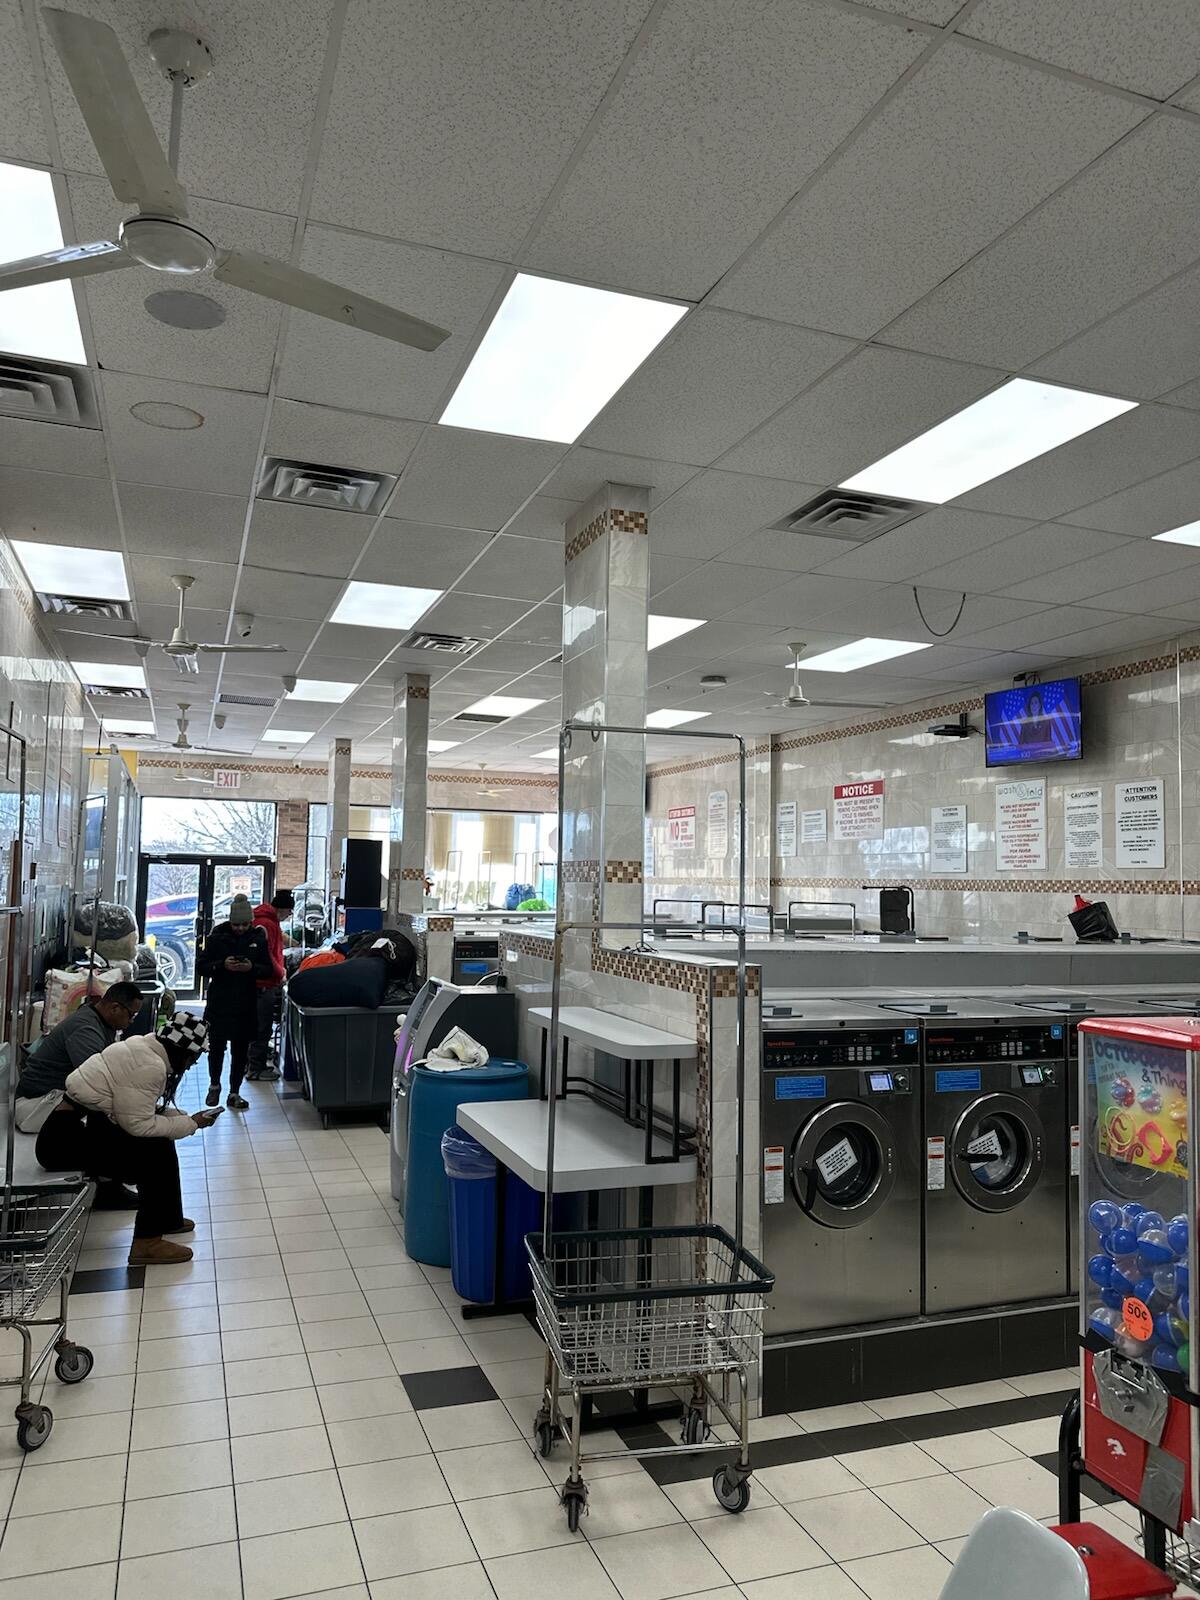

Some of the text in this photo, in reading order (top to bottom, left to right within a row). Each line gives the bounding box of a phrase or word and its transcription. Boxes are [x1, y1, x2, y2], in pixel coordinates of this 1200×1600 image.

[217, 771, 239, 787] EXIT
[842, 784, 874, 797] NOTICE
[1026, 786, 1043, 798] fold
[1125, 785, 1157, 794] ATTENTION
[1124, 794, 1158, 802] CUSTOMERS
[1142, 1068, 1152, 1083] &
